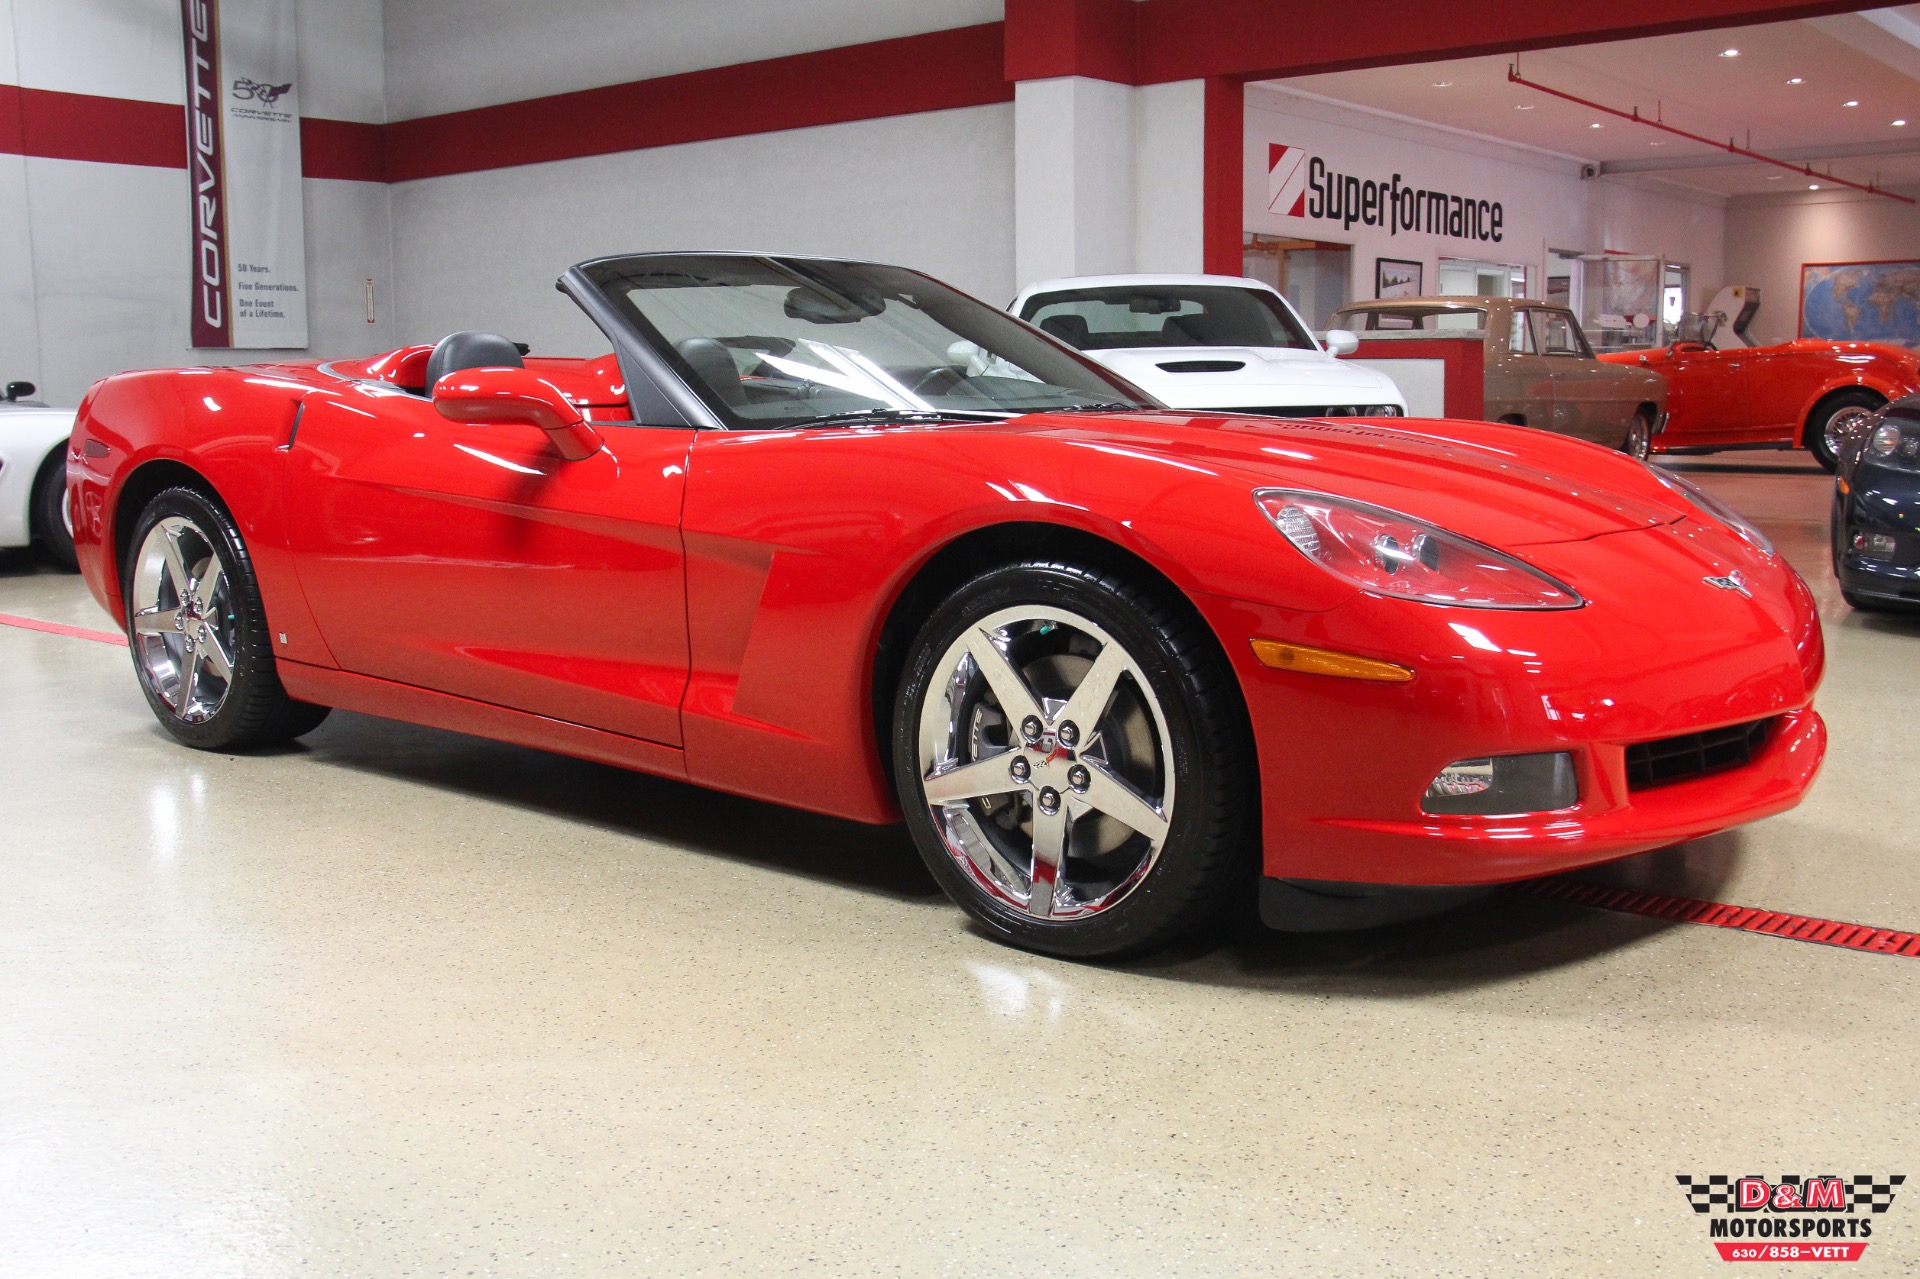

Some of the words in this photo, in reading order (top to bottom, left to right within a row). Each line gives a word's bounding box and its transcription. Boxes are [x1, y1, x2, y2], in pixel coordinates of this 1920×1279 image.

[231, 107, 292, 118] CORVETTE
[191, 0, 222, 328] CORVETTE
[1308, 156, 1503, 242] Superformance
[238, 263, 247, 272] 50
[249, 264, 271, 273] Years.
[238, 281, 253, 290] Five
[254, 282, 299, 291] Generations.
[239, 298, 253, 307] One
[255, 299, 275, 307] Event
[240, 309, 247, 317] of
[255, 309, 286, 318] Lifetime.
